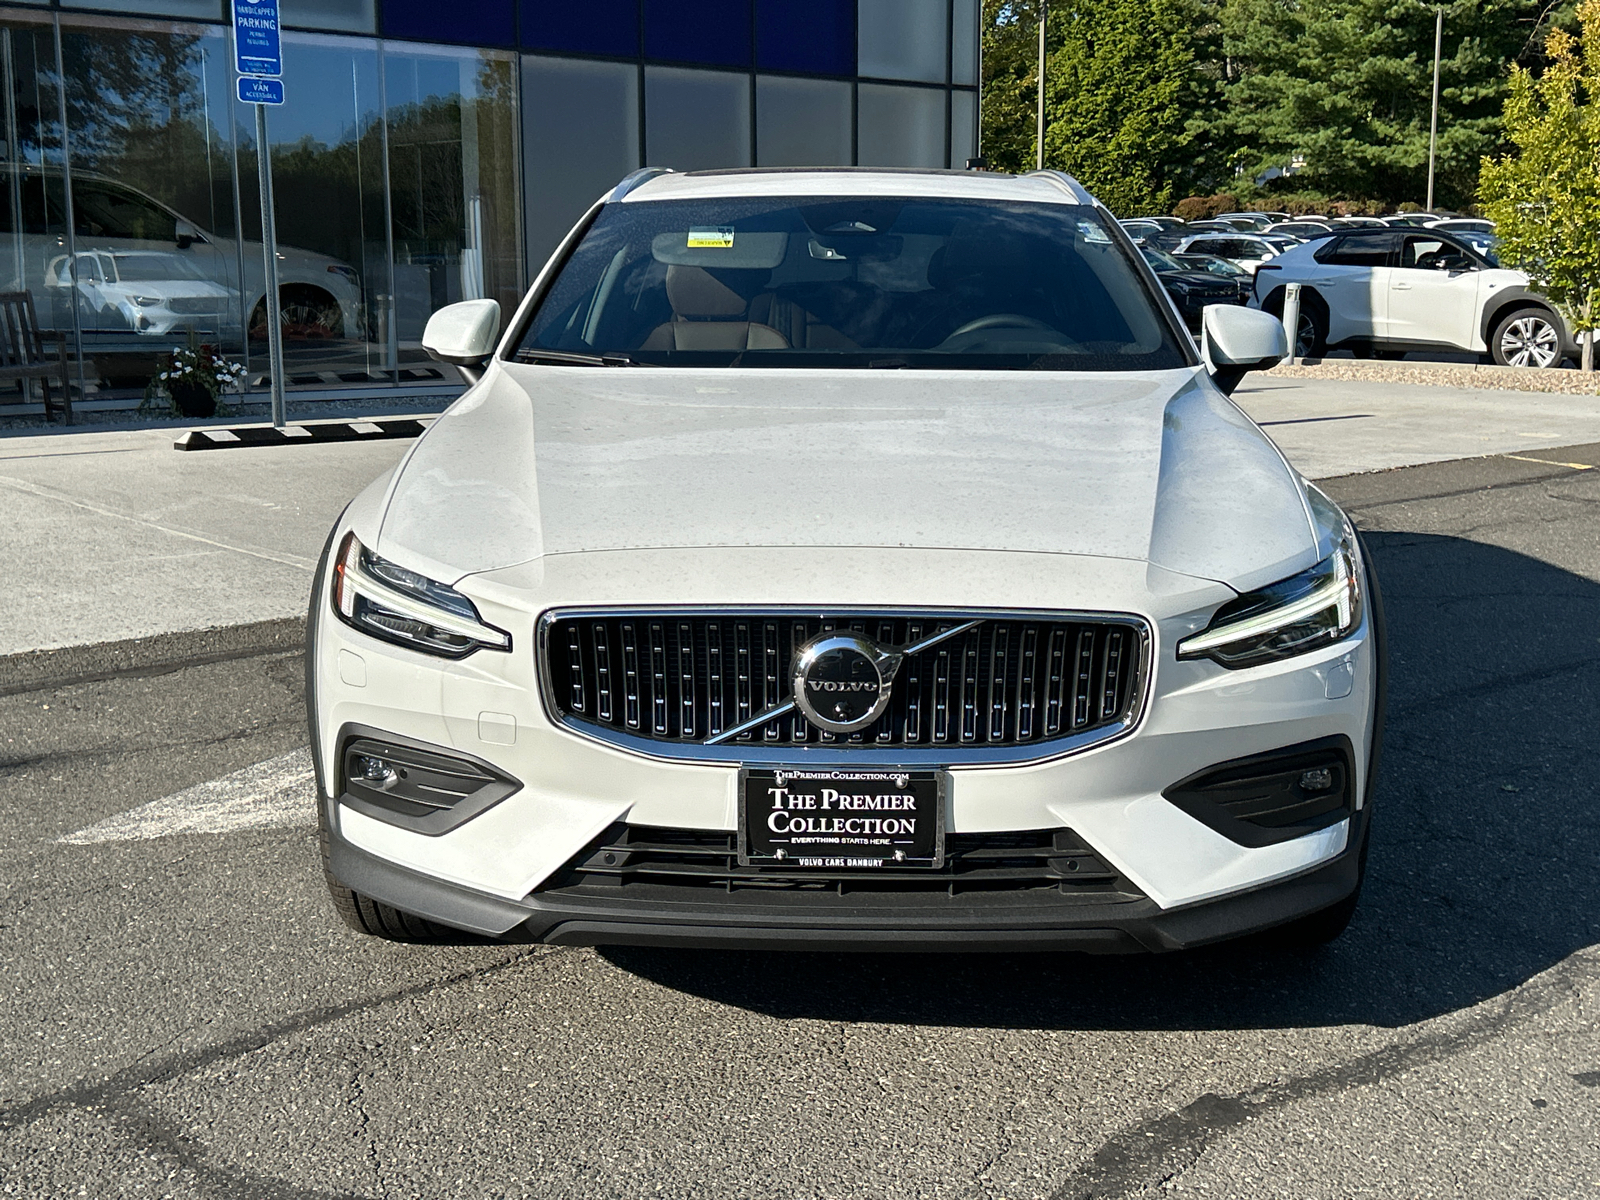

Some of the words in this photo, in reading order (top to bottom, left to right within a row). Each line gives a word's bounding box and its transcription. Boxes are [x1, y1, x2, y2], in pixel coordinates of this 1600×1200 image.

[238, 16, 276, 30] PARKING
[252, 84, 268, 92] VAN
[808, 680, 878, 692] VOLVO
[768, 787, 816, 810] THE
[820, 788, 916, 811] PREMIER
[767, 810, 916, 834] COLLECTION
[799, 858, 823, 866] VOLVO
[825, 858, 844, 867] CARS
[847, 858, 883, 867] DANBURY
